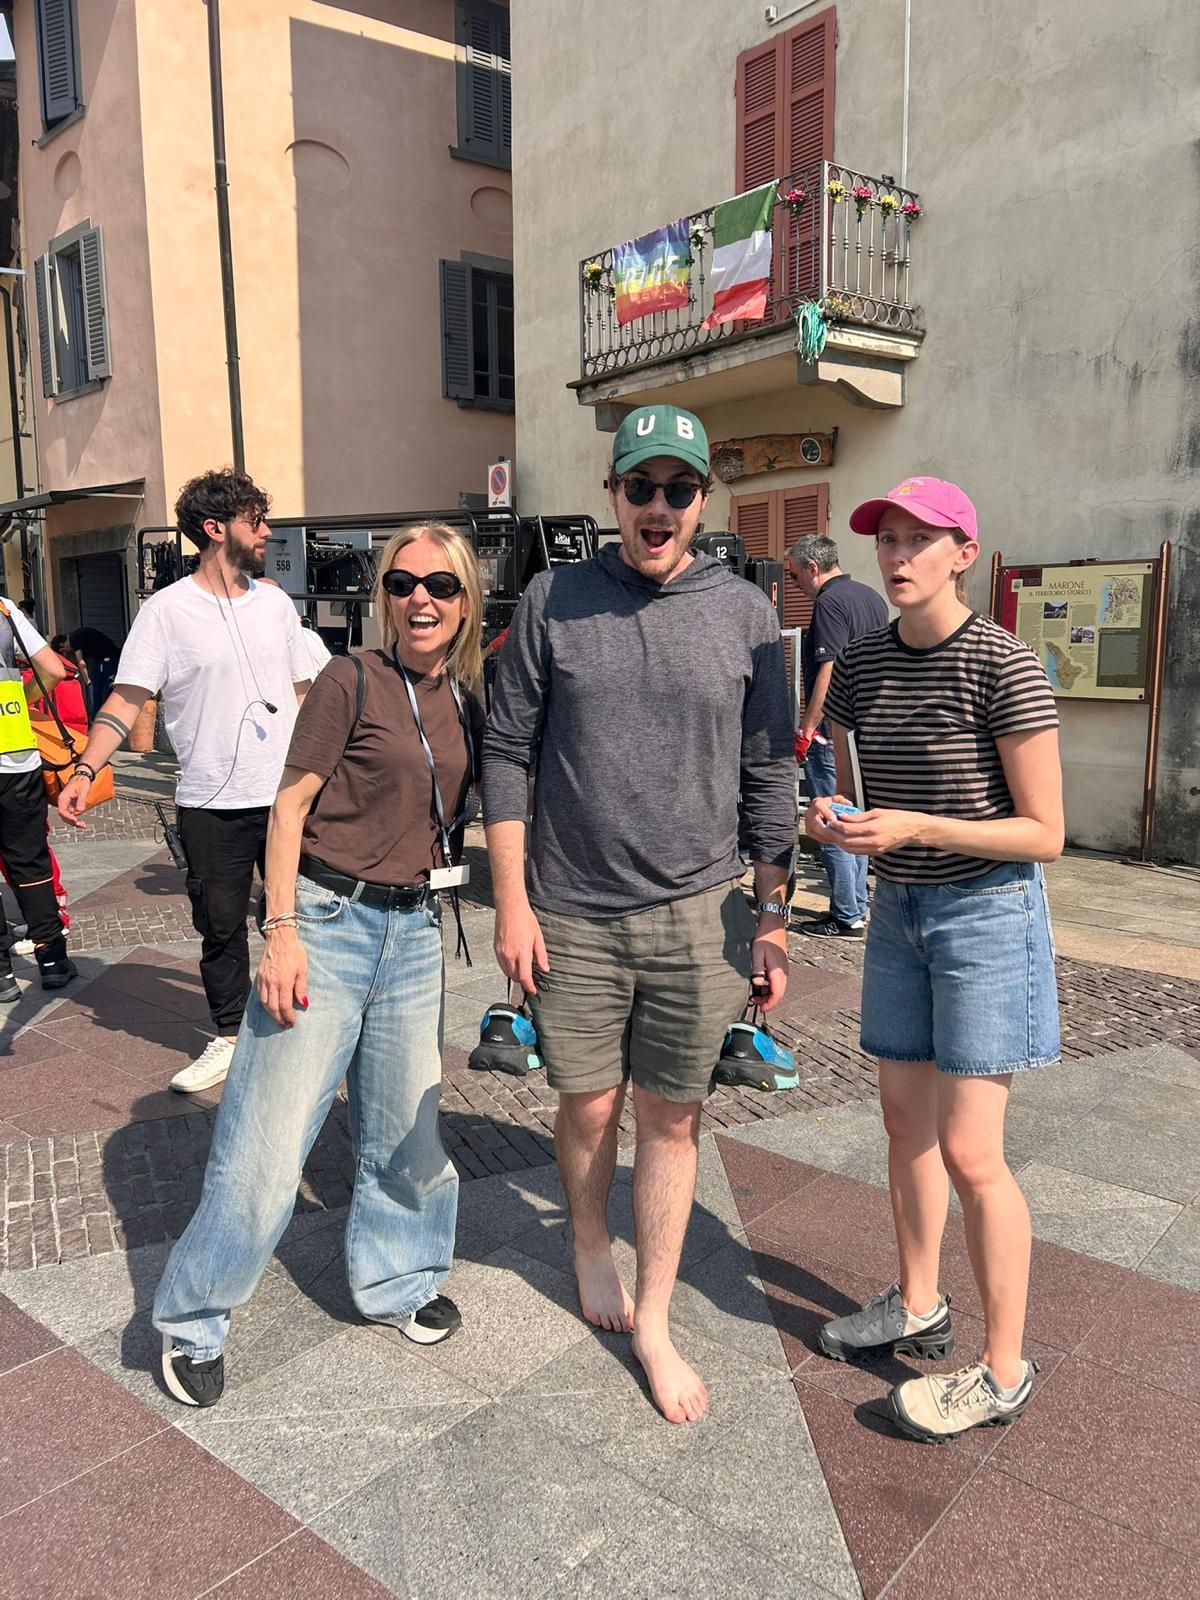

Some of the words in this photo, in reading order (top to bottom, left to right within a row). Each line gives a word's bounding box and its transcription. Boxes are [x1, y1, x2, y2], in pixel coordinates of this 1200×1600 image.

[716, 546, 728, 559] 12
[276, 560, 291, 571] 558
[1049, 580, 1086, 589] MARONE
